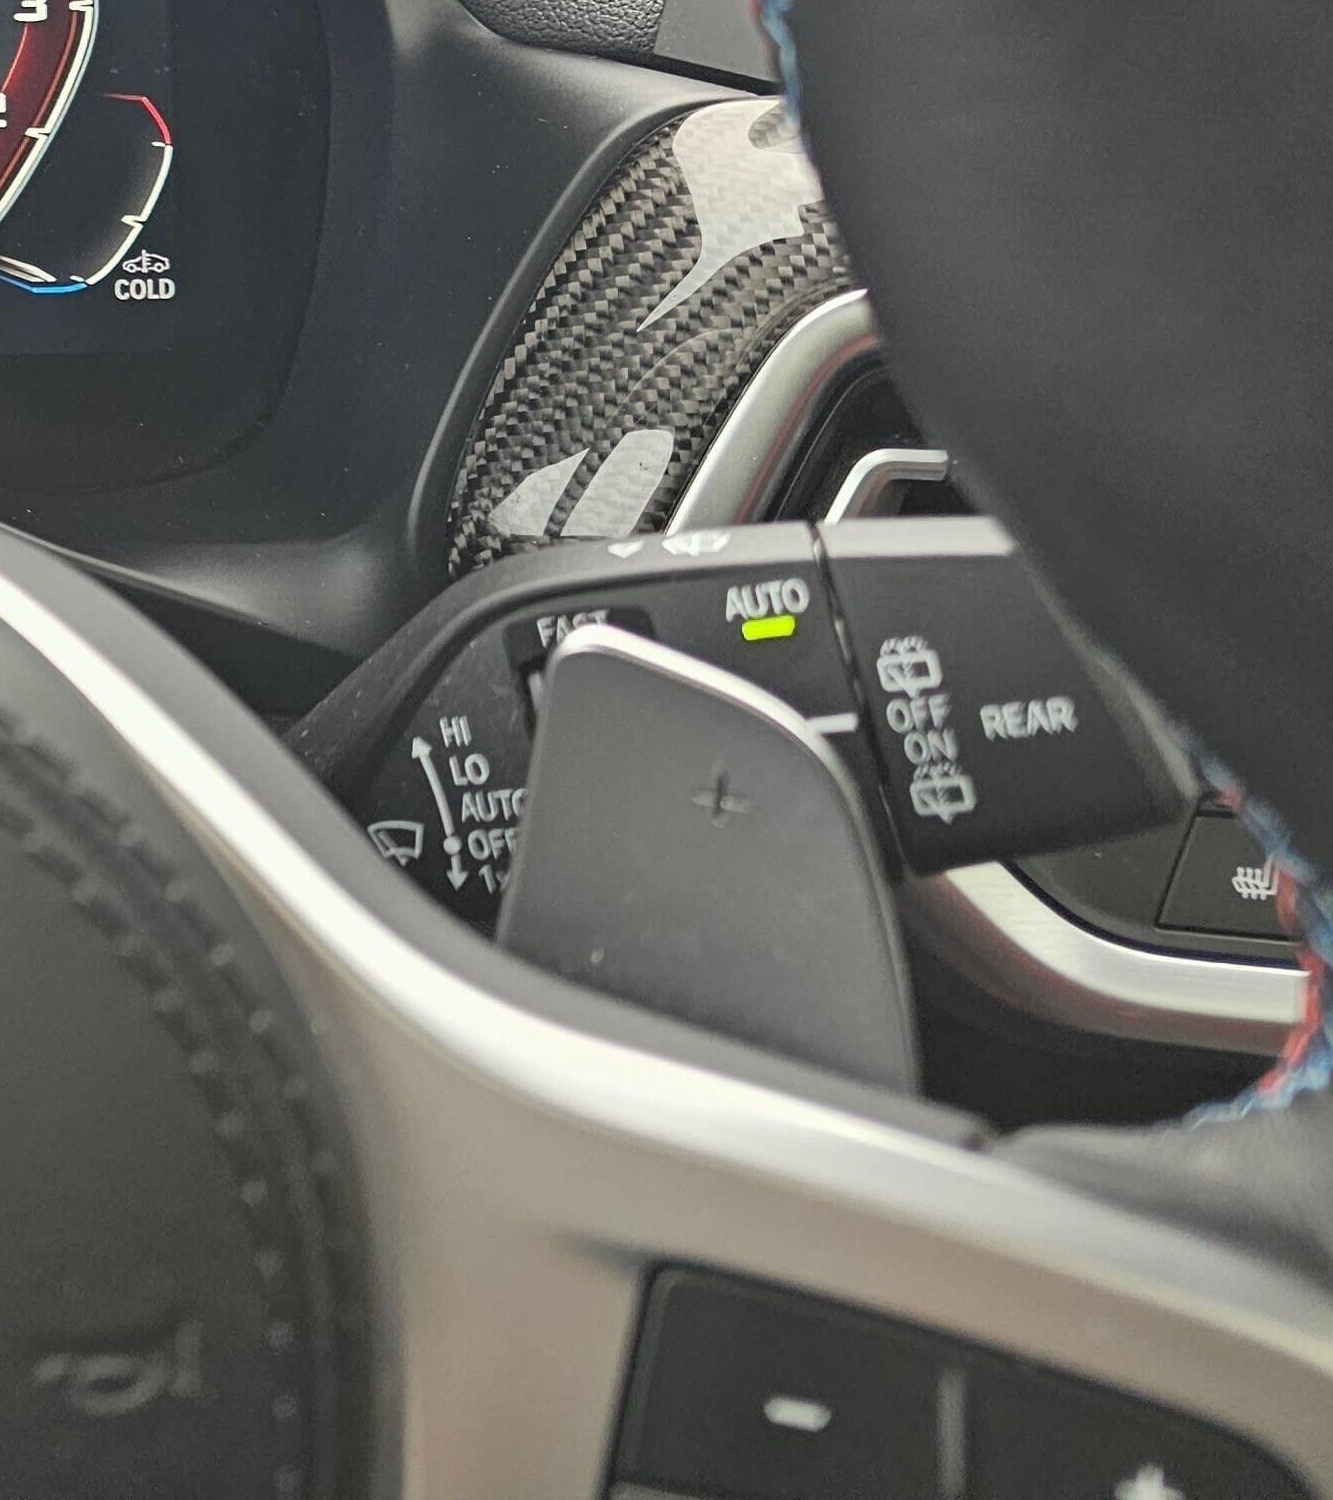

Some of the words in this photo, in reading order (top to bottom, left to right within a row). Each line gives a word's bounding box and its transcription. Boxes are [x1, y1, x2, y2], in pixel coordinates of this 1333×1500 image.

[113, 278, 177, 301] COLD
[725, 577, 810, 622] AUTO
[438, 714, 473, 749] HI
[885, 693, 953, 735] OFF
[979, 696, 1078, 741] REAR
[903, 730, 959, 765] ON
[448, 752, 491, 787] LO
